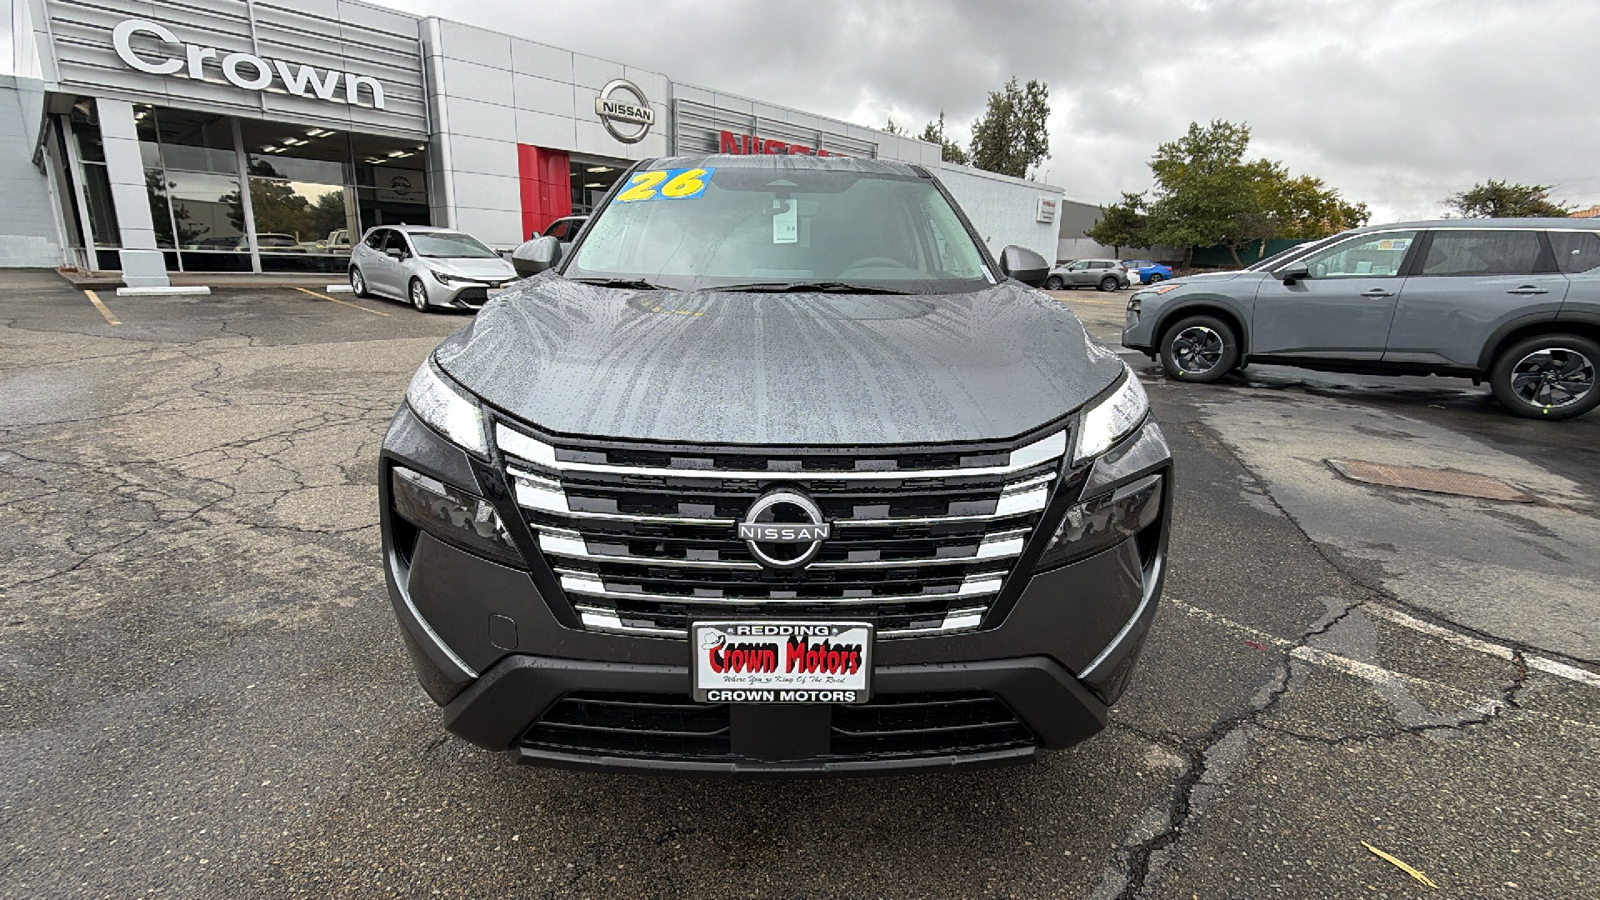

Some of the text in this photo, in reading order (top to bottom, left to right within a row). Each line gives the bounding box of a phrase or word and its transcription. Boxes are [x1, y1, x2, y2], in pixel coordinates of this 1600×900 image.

[112, 18, 386, 110] Crown
[603, 102, 651, 121] NISSAN
[616, 167, 708, 202] 26
[740, 526, 828, 540] NISSAN
[737, 625, 829, 636] REDDING
[709, 636, 863, 675] Crown Motors
[723, 675, 746, 683] Where
[748, 675, 773, 685] You're
[775, 676, 794, 684] King
[796, 676, 806, 684] Of
[707, 690, 856, 702] CROWN MOTORS
